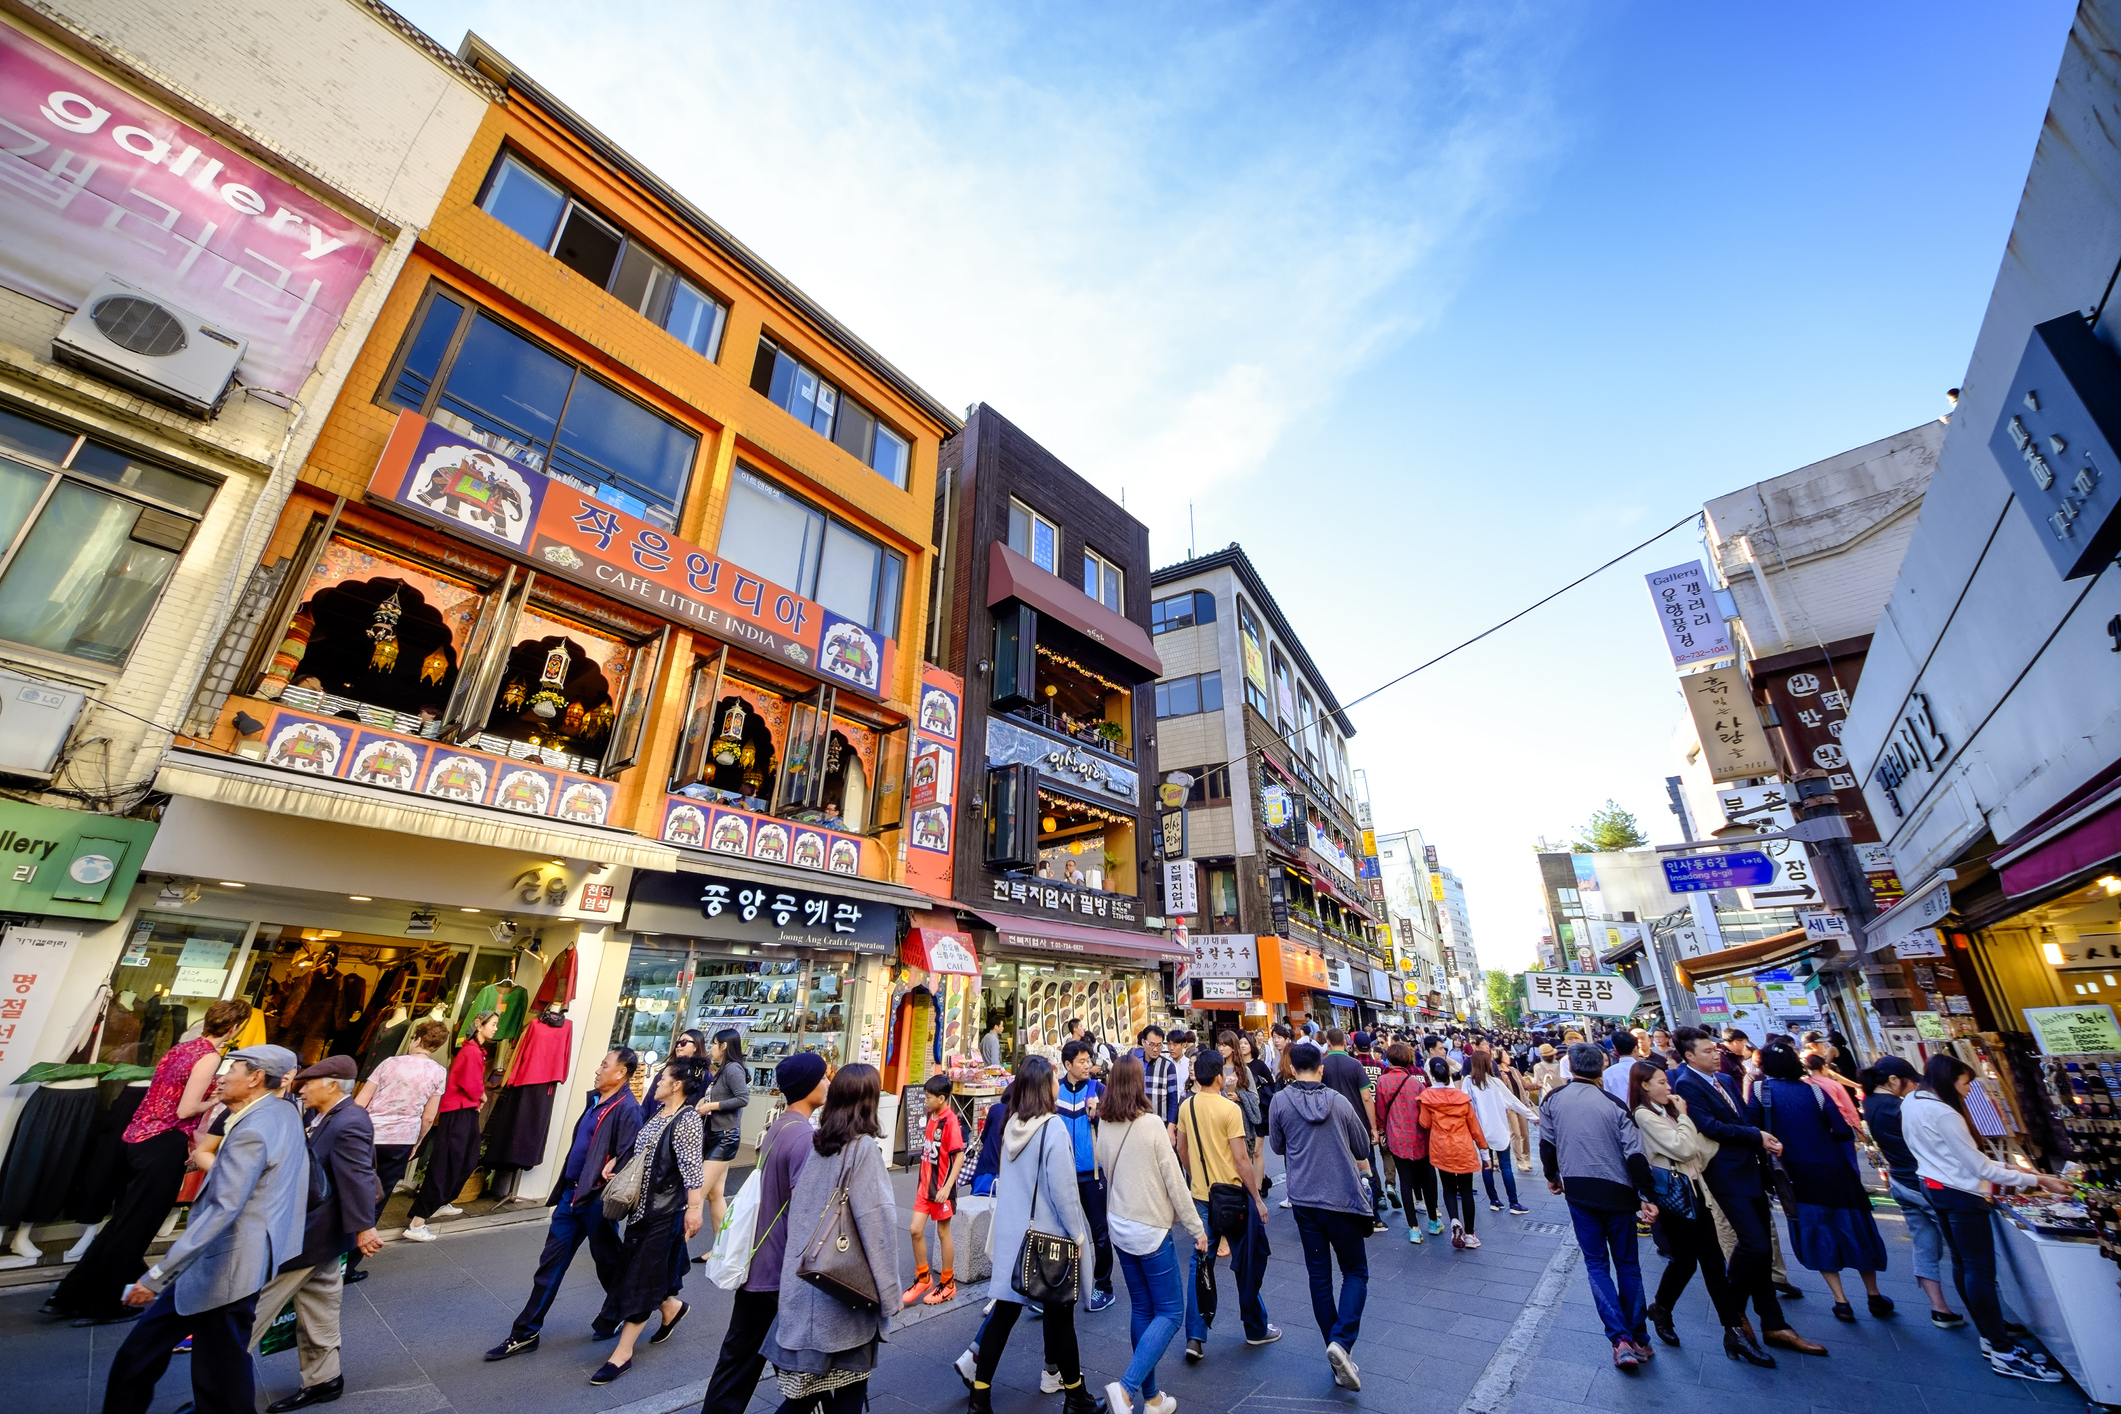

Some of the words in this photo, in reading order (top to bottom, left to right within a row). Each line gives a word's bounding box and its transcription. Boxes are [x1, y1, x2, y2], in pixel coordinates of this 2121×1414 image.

[40, 91, 346, 260] gallery
[1653, 568, 1698, 586] Gallery
[595, 564, 652, 599] CAFÉ
[658, 589, 719, 626] LITTLE
[725, 616, 775, 650] INDIA
[1681, 581, 1711, 626] 갤러리
[1661, 587, 1695, 648] 운향풍경
[1675, 645, 1730, 662] 02-732-1041
[41, 695, 60, 706] LG
[1167, 790, 1181, 800] HOF
[1666, 857, 1728, 873] 인사동6길
[1785, 860, 1807, 881] 장
[1670, 871, 1710, 882] Insadong
[1711, 869, 1733, 879] 6-gil
[1170, 865, 1184, 910] 전북지업사
[993, 880, 1075, 911] 전북지업사
[1080, 895, 1107, 917] 필방
[701, 884, 862, 933] 중앙공예관
[1808, 917, 1844, 932] 세탁
[778, 931, 803, 944] Joong
[805, 934, 823, 946] Ang
[823, 936, 843, 947] Craft
[902, 951, 924, 969] INDIA
[946, 962, 964, 970] CAFÉ
[1535, 976, 1613, 1000] 북촌공장
[1557, 999, 1599, 1012] 고로케
[2034, 1012, 2075, 1026] leather
[2075, 1012, 2107, 1024] Belt
